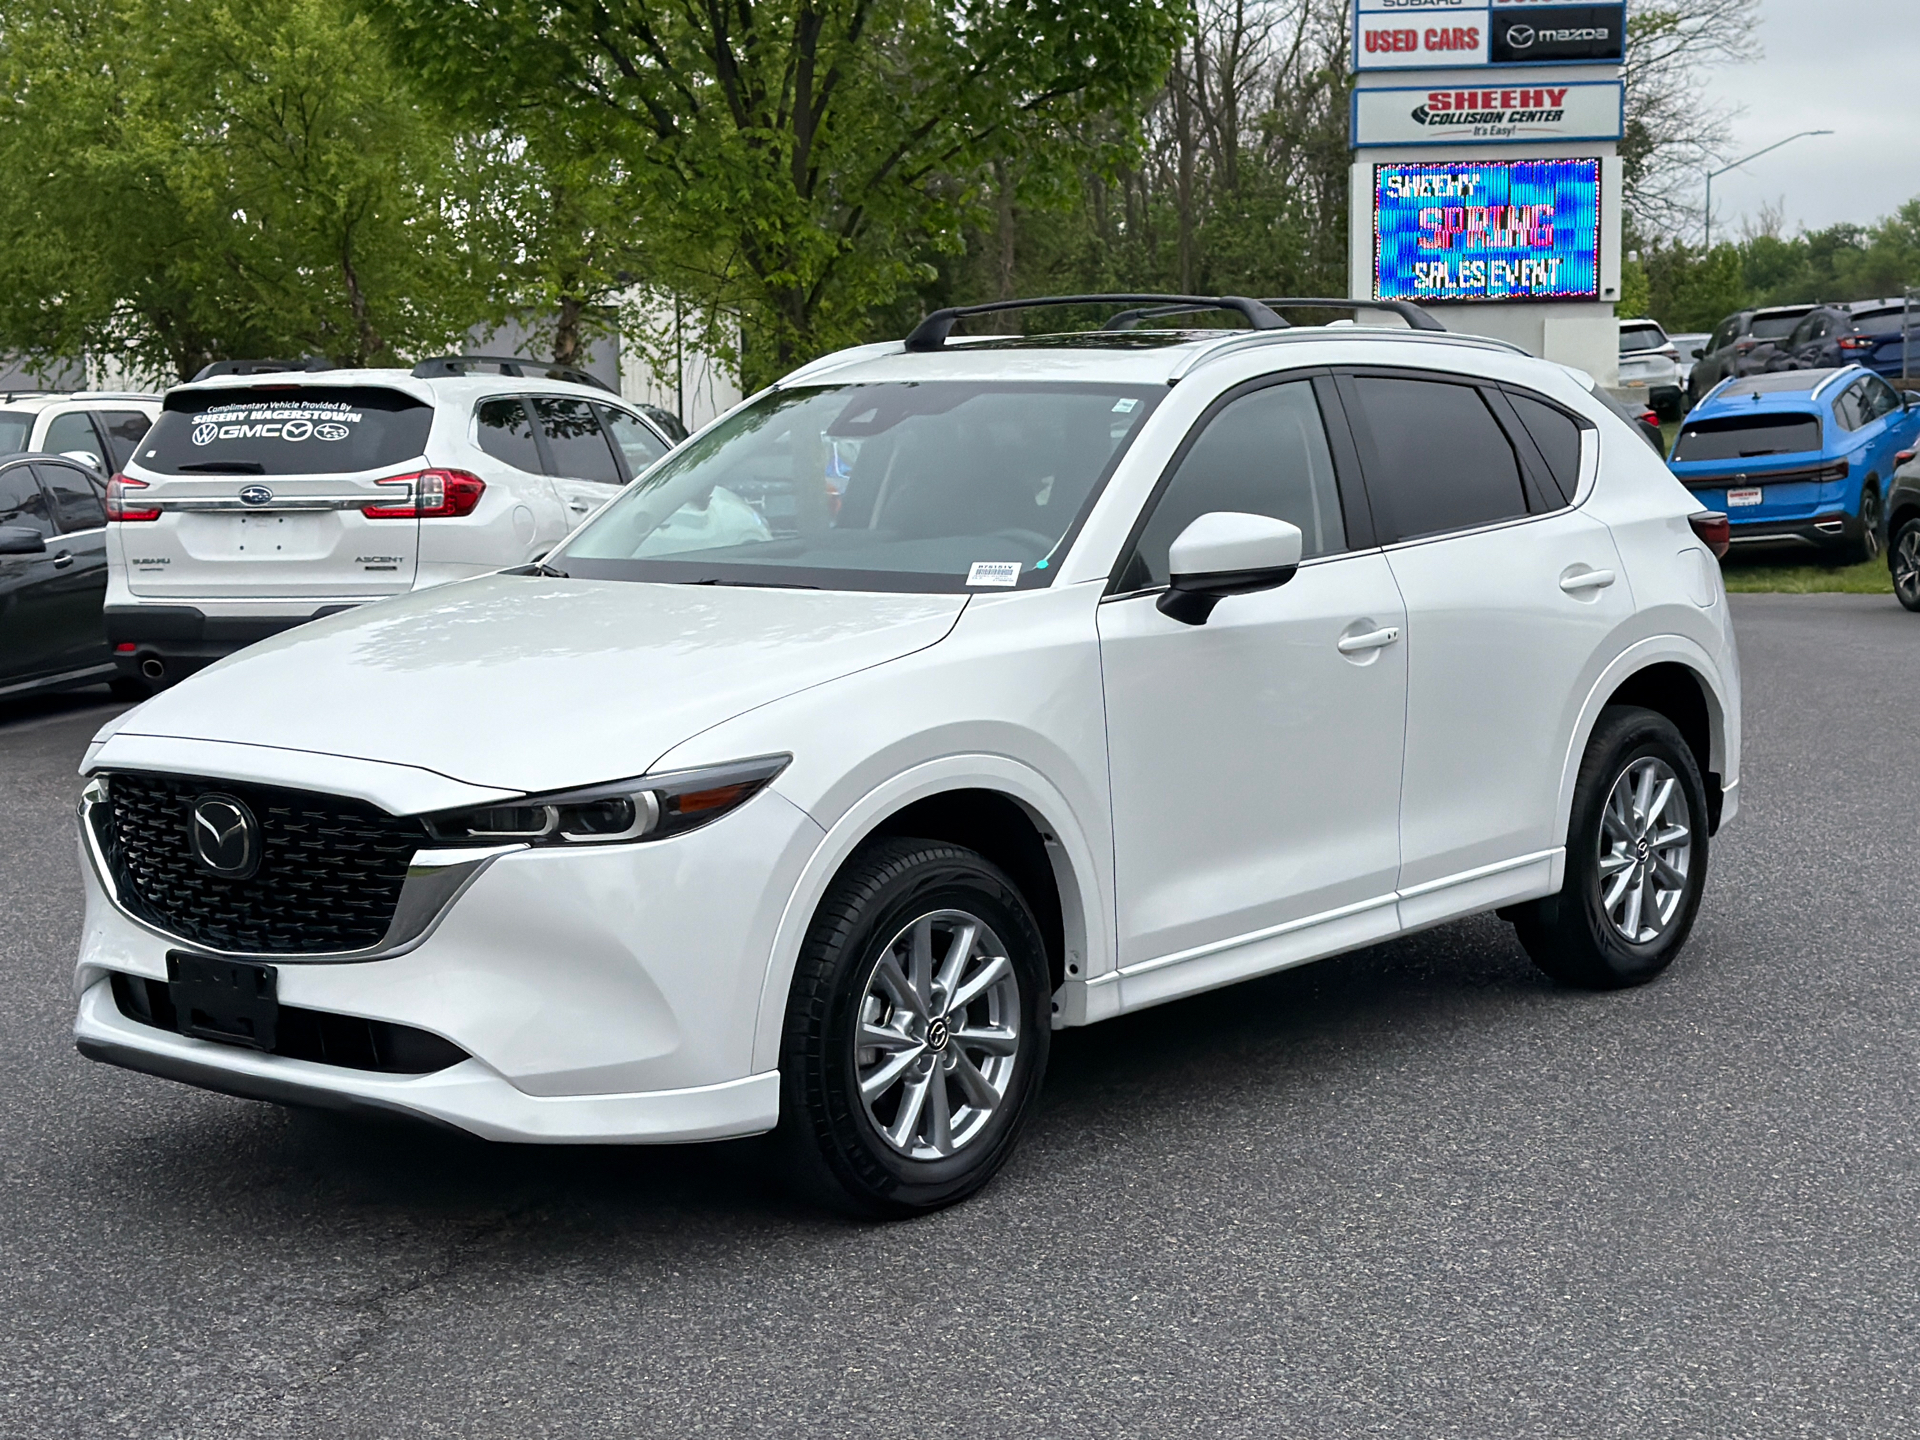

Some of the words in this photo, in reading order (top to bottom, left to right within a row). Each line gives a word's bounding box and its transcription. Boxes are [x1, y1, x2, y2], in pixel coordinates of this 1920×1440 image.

[1365, 29, 1418, 53] USED
[1424, 28, 1480, 51] CARS
[1538, 28, 1609, 42] mazda
[1427, 88, 1568, 111] SHEEHY
[1428, 111, 1505, 126] COLLISION
[1507, 109, 1564, 123] CENTER
[1473, 126, 1488, 136] It's
[1490, 125, 1516, 137] Easy!
[207, 403, 269, 414] Complimentary
[269, 401, 300, 410] Vehicle
[301, 402, 339, 411] Provided
[339, 403, 352, 412] By
[191, 411, 248, 424] SHEEHY
[250, 410, 362, 423] HAGERSTOWN
[218, 424, 283, 439] GMC
